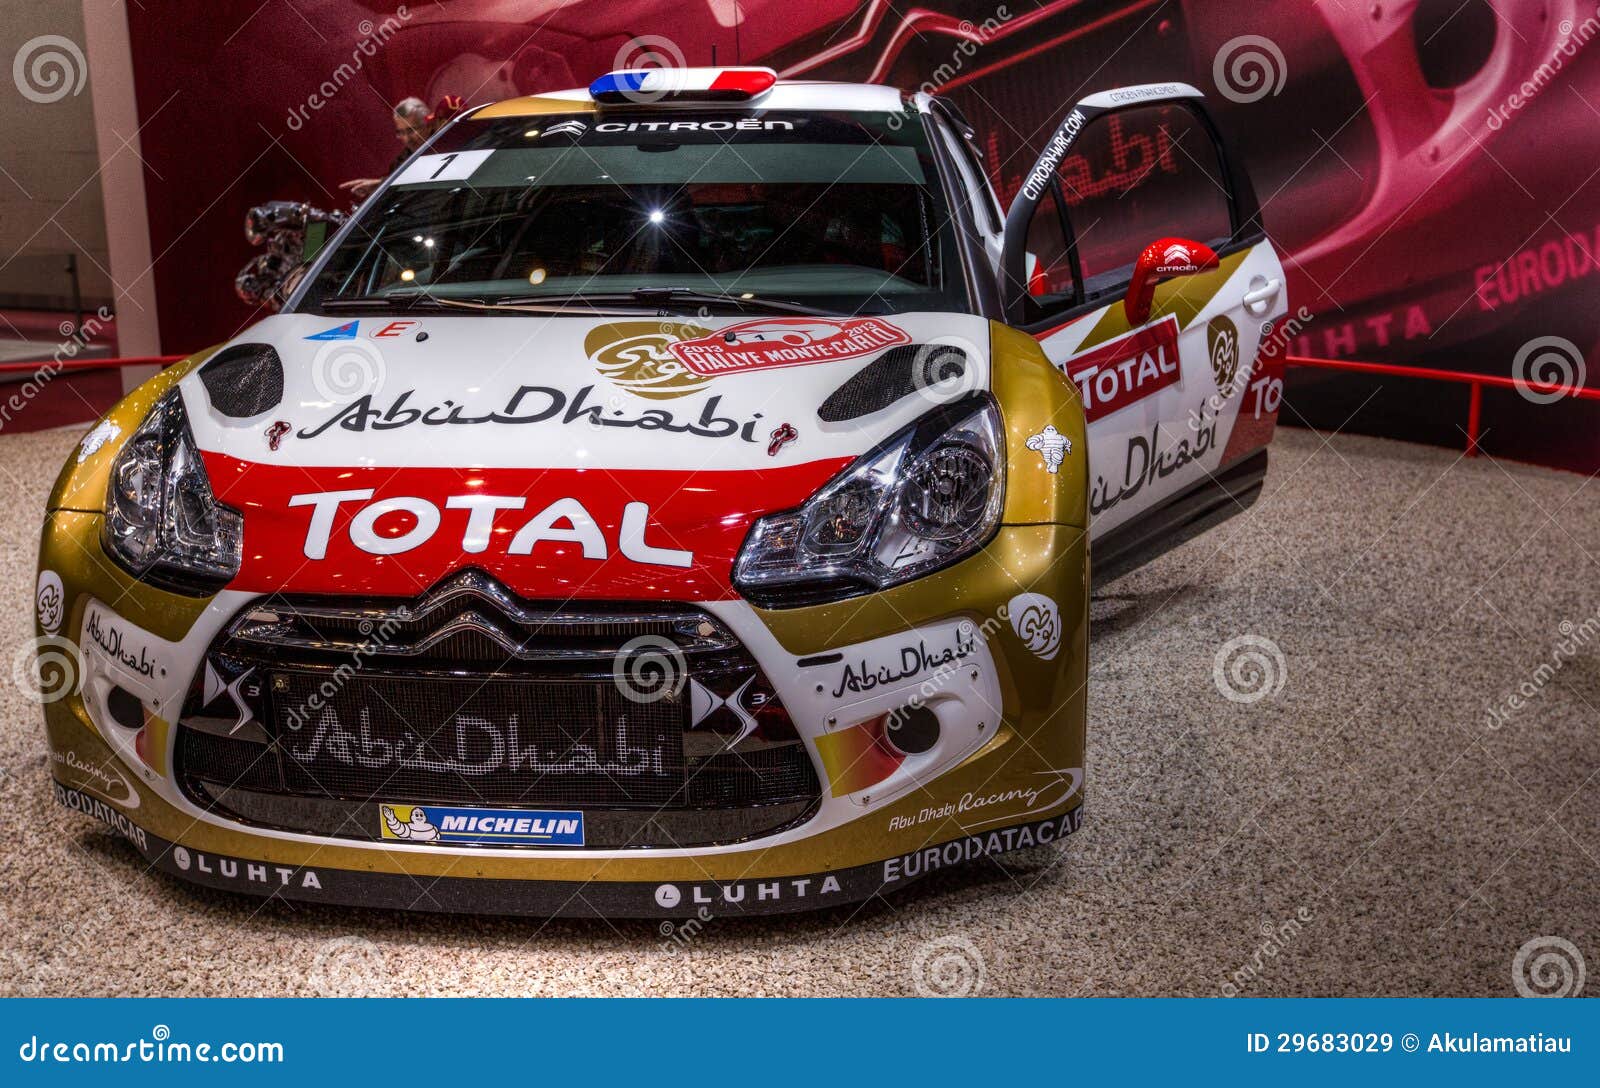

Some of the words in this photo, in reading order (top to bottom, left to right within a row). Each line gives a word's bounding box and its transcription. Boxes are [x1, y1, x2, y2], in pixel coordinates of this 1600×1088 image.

[429, 153, 460, 180] 1
[1023, 108, 1087, 201] CITROEN-WRC.COM
[679, 344, 724, 354] 2013
[844, 321, 879, 338] 2013
[682, 350, 766, 372] RALLYE
[763, 327, 899, 363] MONTE-CARLO
[1073, 345, 1177, 410] TOTAL
[297, 389, 485, 440] Abu
[478, 384, 763, 443] Dhabi
[288, 488, 694, 568] TOTAL
[832, 660, 900, 698] Abu
[293, 704, 452, 772] Abu
[450, 713, 669, 777] Dhabi
[55, 782, 148, 851] RODATACAR
[441, 815, 579, 836] MICHELIN
[888, 815, 916, 832] Abu
[918, 804, 957, 823] Dhabi
[197, 854, 322, 890] LUHTA
[693, 875, 841, 903] LUHTA
